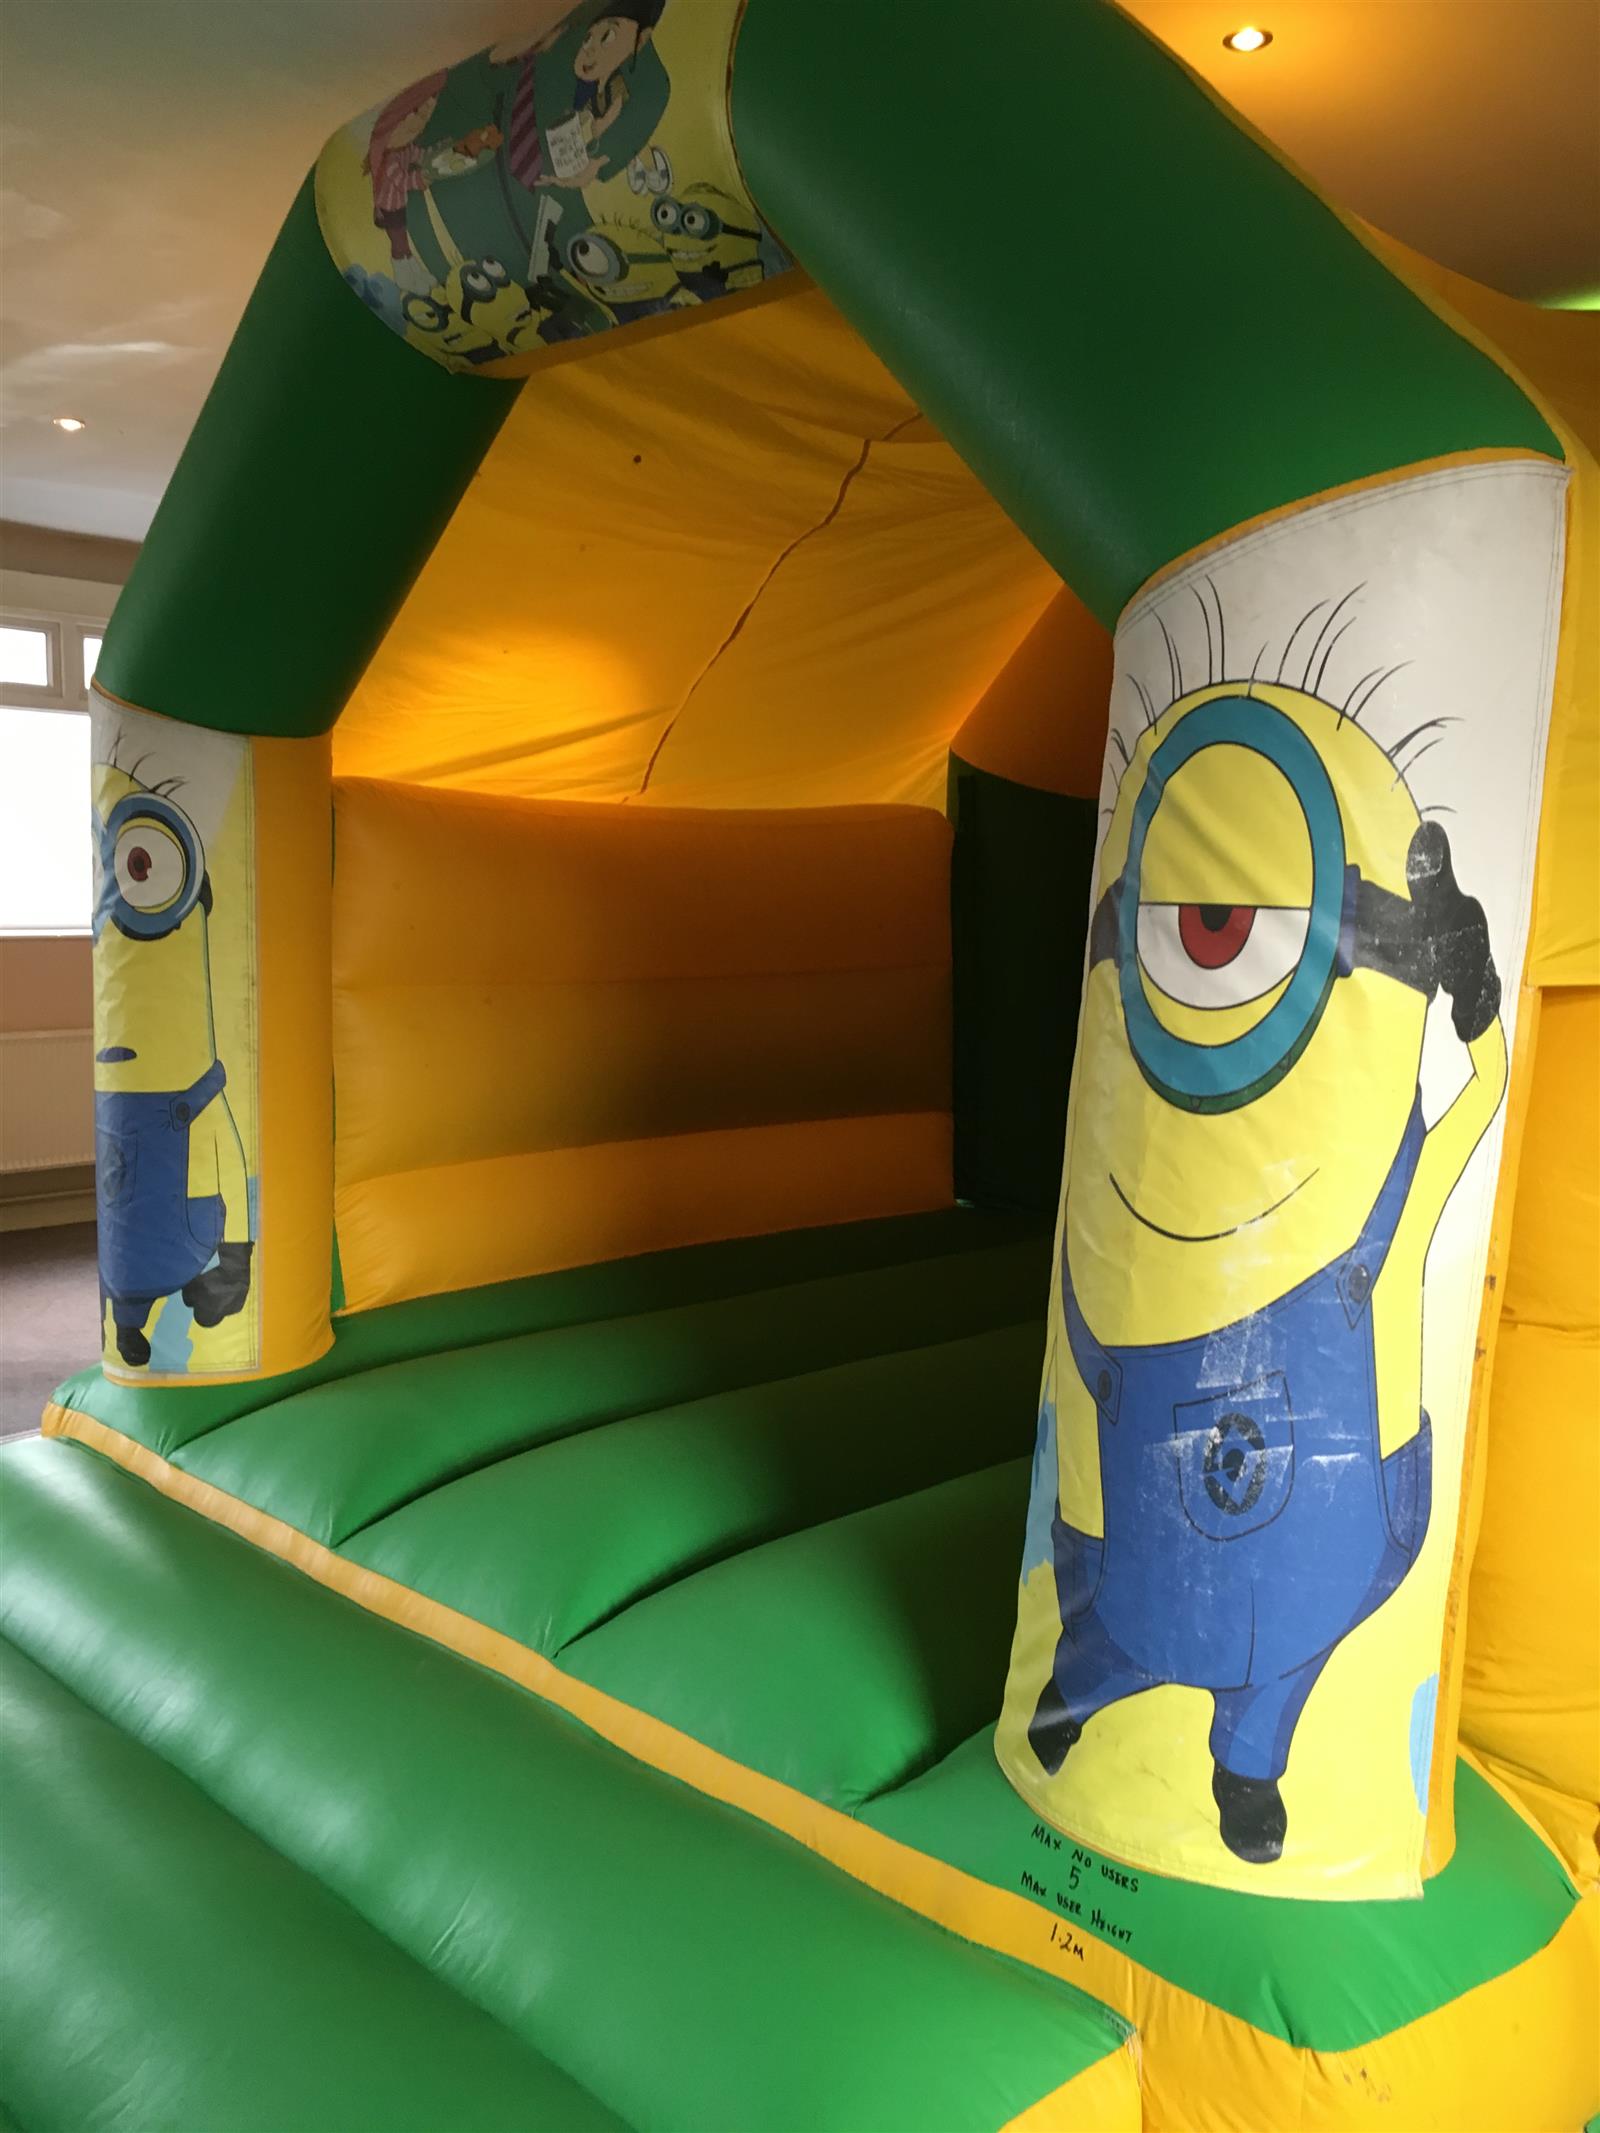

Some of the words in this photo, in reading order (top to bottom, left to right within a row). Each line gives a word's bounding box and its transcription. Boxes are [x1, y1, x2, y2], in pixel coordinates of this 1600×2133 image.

[1031, 1823, 1062, 1850] MAX
[1101, 1864, 1139, 1893] USERS
[1069, 1865, 1081, 1890] 5
[1057, 1892, 1082, 1915] USER
